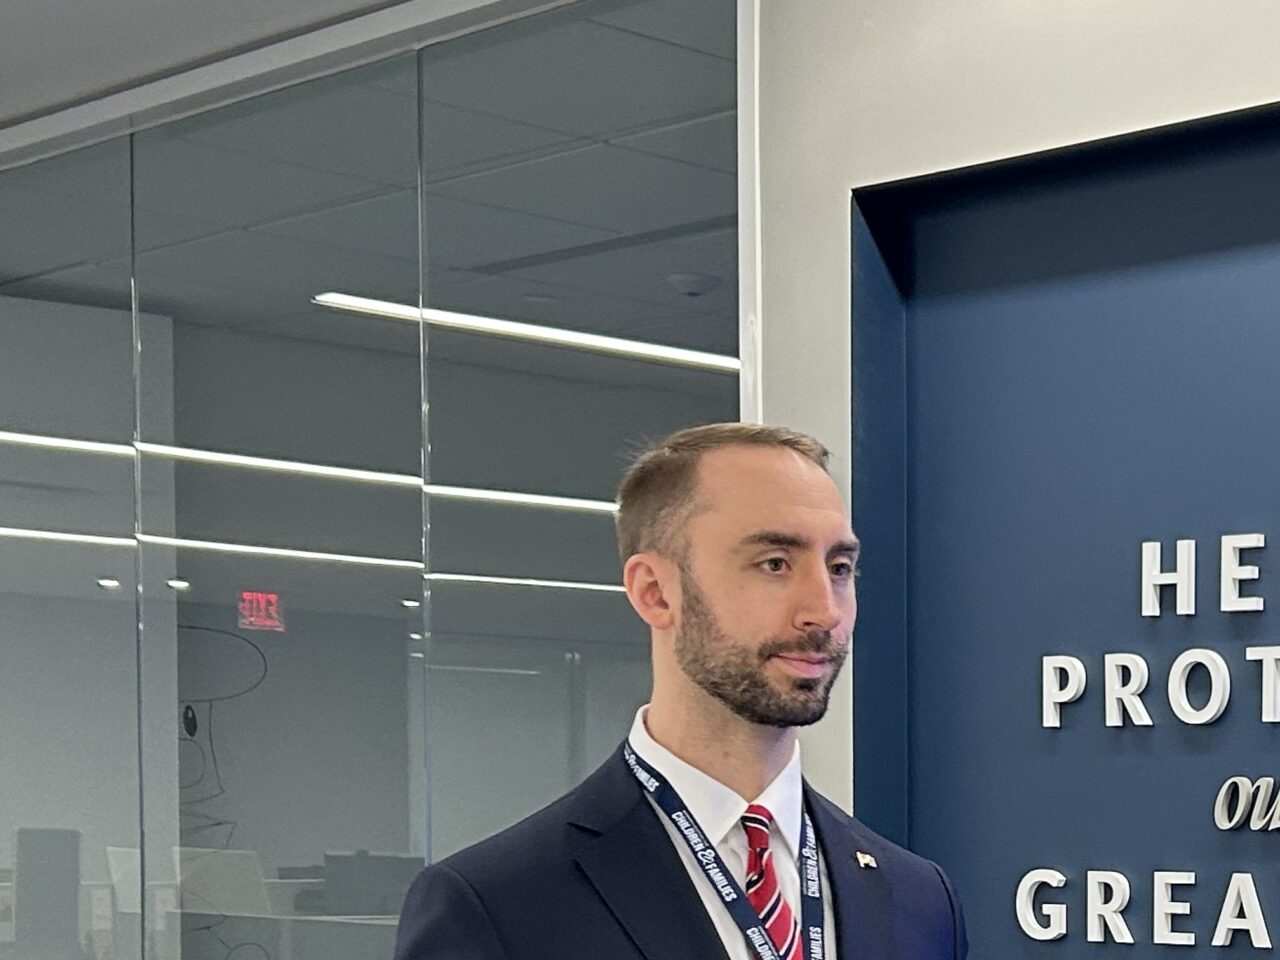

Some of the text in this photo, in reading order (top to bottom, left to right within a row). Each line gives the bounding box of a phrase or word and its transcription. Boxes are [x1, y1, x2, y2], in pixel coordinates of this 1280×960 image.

[671, 811, 705, 852] CHILDREN
[697, 849, 716, 865] &
[705, 863, 738, 902] FAMILIES
